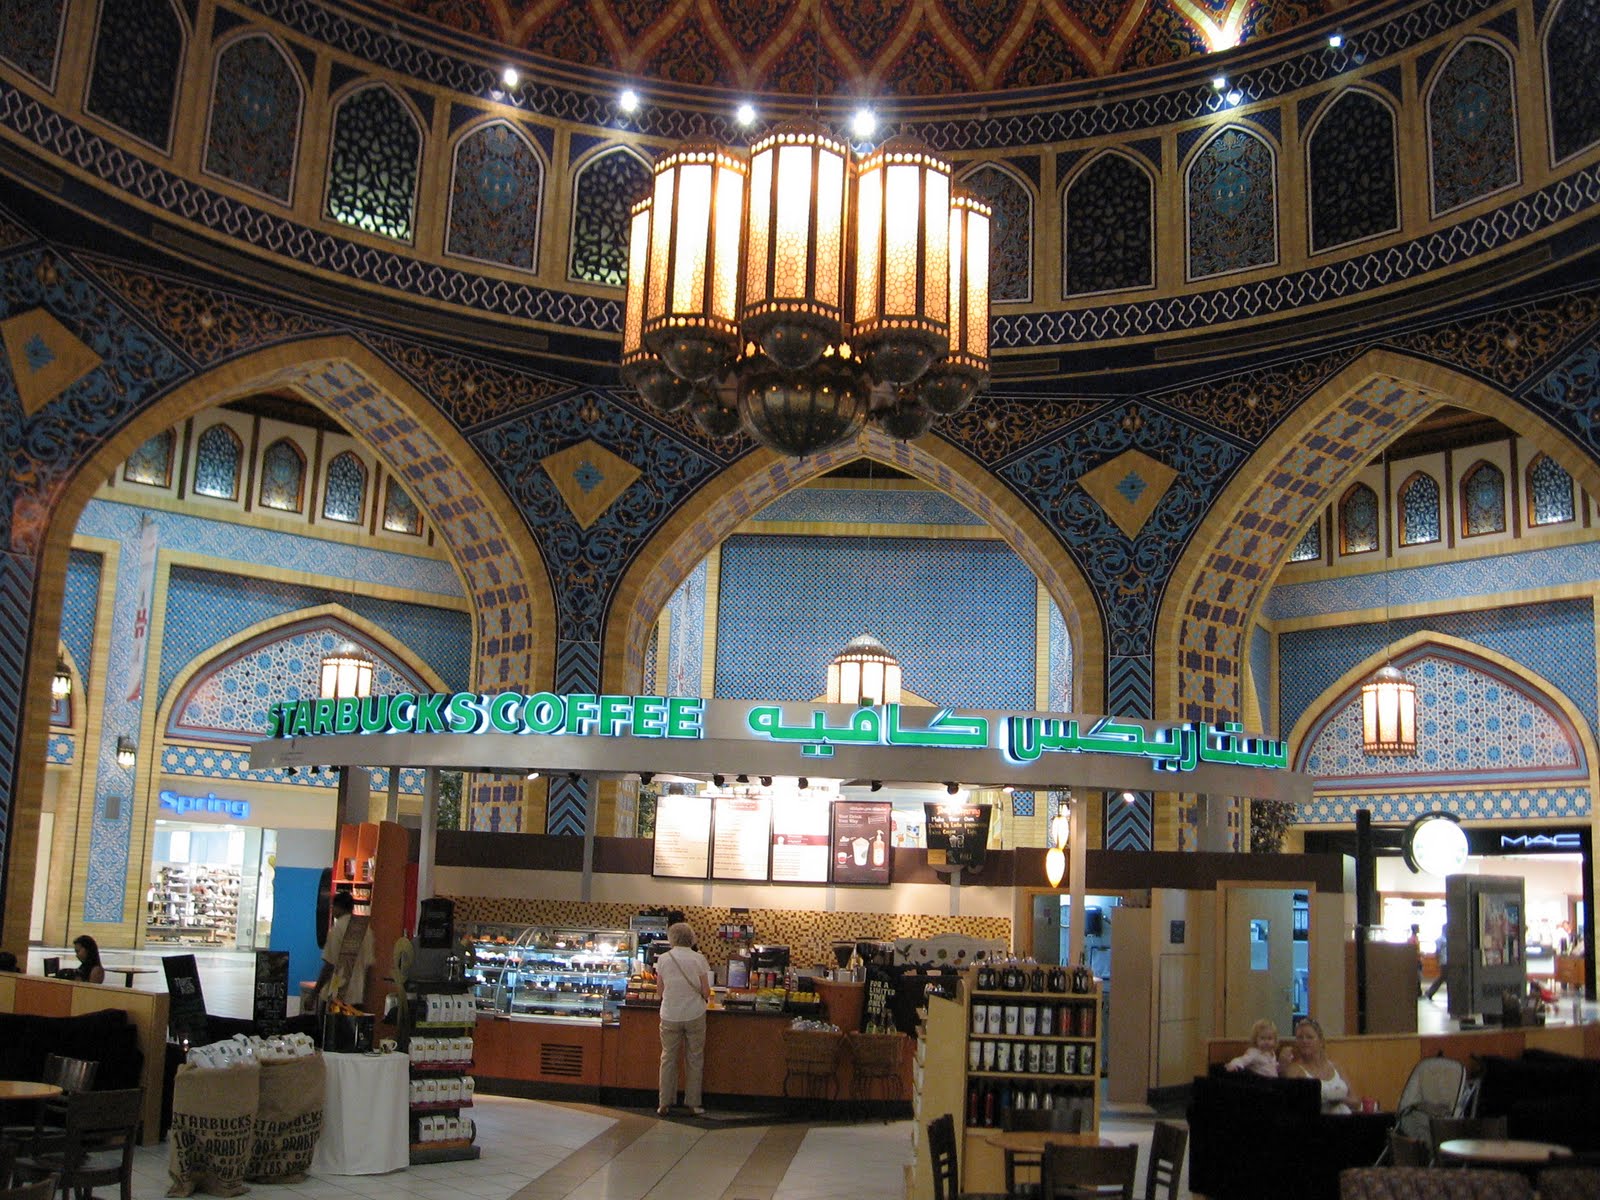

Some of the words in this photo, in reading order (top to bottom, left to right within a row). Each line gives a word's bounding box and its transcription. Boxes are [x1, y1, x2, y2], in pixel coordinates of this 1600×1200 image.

[266, 692, 480, 738] STARBUCKS
[489, 691, 705, 739] COFFEE
[160, 790, 250, 820] Spring
[869, 986, 896, 996] LIMITED
[884, 981, 889, 989] A
